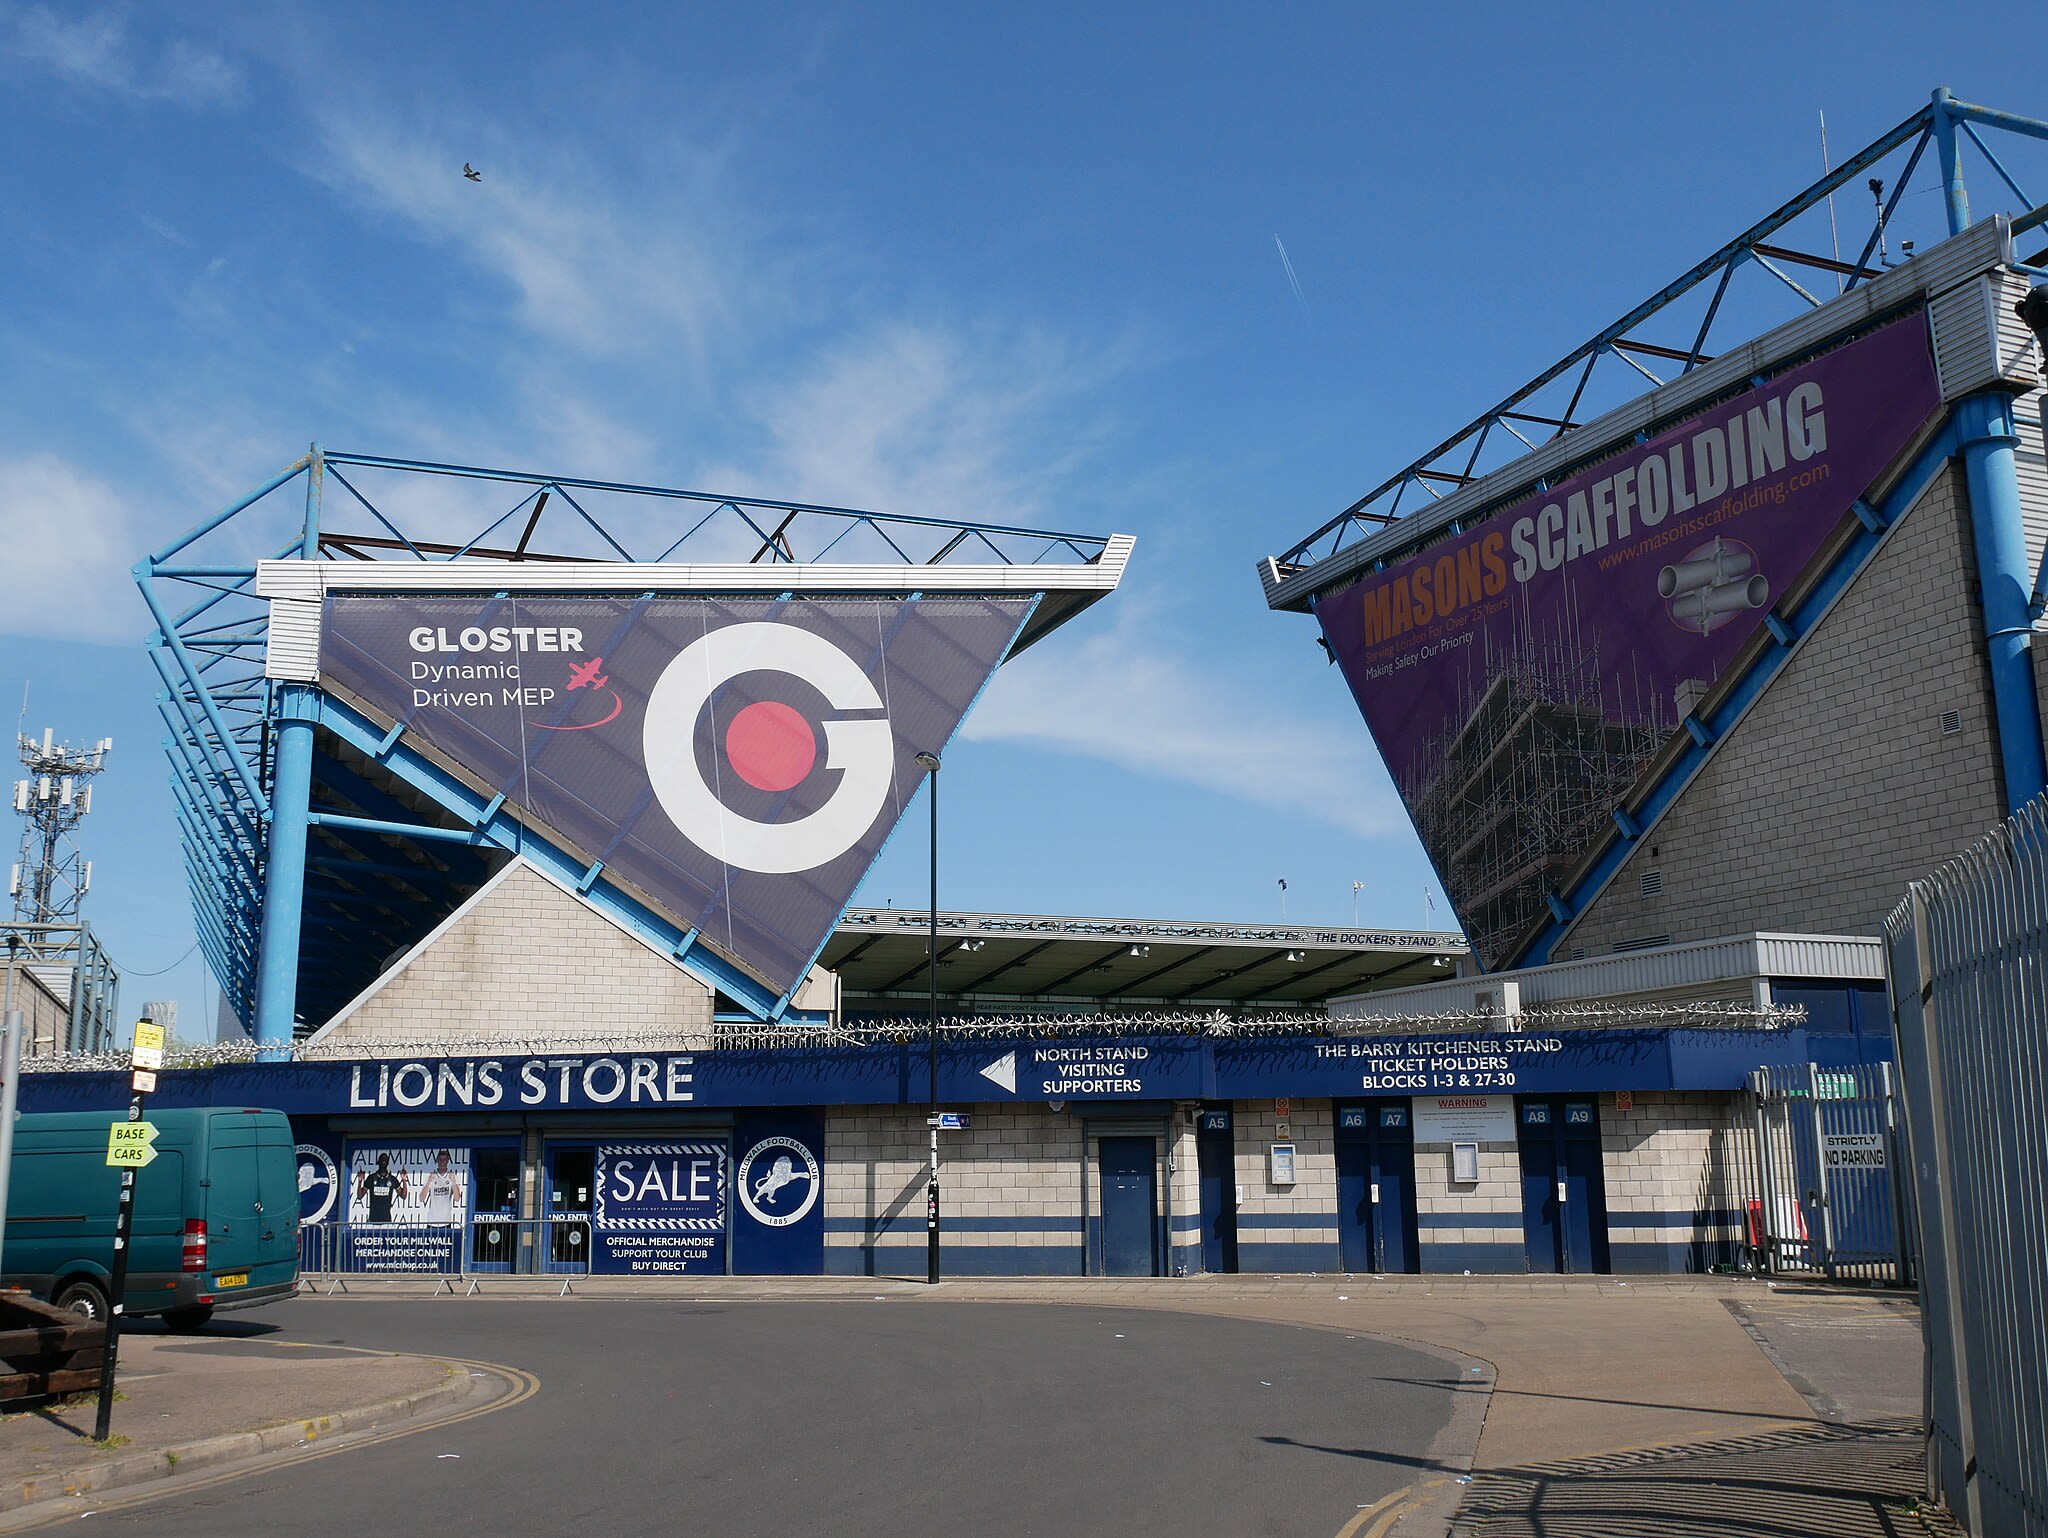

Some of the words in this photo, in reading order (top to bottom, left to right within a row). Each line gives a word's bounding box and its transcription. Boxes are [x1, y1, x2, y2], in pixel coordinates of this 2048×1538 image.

[1363, 532, 1507, 648] MASONS
[1511, 381, 1828, 583] SCAFFOLDING
[1598, 460, 1830, 571] www.masonsscaffolding.com
[1395, 632, 1427, 652] London
[1428, 624, 1443, 638] For
[1445, 614, 1469, 631] Over
[1471, 606, 1484, 621] 25
[1484, 598, 1510, 616] Years
[408, 627, 584, 652] GLOSTER
[1366, 663, 1394, 680] Making
[1394, 650, 1419, 671] Safety
[1420, 645, 1439, 660] Our
[1440, 630, 1474, 652] Priority
[411, 661, 520, 684] Dynamic
[413, 688, 493, 707] Driven
[503, 687, 555, 706] MEP
[1315, 932, 1337, 943] THE
[1340, 933, 1396, 945] DOCKERS
[1398, 935, 1437, 946] STAND
[1035, 1048, 1092, 1063] NORTH
[1095, 1046, 1149, 1060] STAND
[1314, 1045, 1347, 1057] THE
[1351, 1043, 1402, 1056] BARRY
[1407, 1040, 1501, 1055] KITCHENER
[1505, 1039, 1563, 1052] STAND
[1058, 1063, 1125, 1077] VISITING
[1368, 1058, 1426, 1072] TICKET
[1431, 1057, 1508, 1071] HOLDERS
[350, 1061, 503, 1107] LIONS
[520, 1056, 694, 1105] STORE
[1042, 1079, 1142, 1094] SUPPORTERS
[1363, 1075, 1427, 1089] BLOCKS
[1433, 1074, 1454, 1087] 1-3
[1458, 1074, 1470, 1087] &
[1474, 1073, 1516, 1087] 27-30
[1438, 1098, 1487, 1108] WARNING
[1208, 1118, 1225, 1129] A5
[1345, 1115, 1362, 1126] A6
[1386, 1115, 1401, 1126] A7
[1528, 1111, 1546, 1122] A8
[1571, 1111, 1588, 1122] A9
[116, 1128, 145, 1141] BASE
[1827, 1136, 1877, 1145] STRICTLY
[114, 1148, 143, 1160] CARS
[740, 1143, 766, 1181] MILLWALL
[766, 1137, 807, 1157] FOOTBALL
[807, 1156, 818, 1180] CLUB
[1825, 1150, 1839, 1165] NO
[1841, 1149, 1884, 1165] PARKING
[611, 1160, 711, 1202] SALE
[474, 1214, 516, 1222] ENTRANCE
[552, 1213, 565, 1221] NO
[567, 1213, 593, 1221] ENTRY
[769, 1217, 788, 1225] 1885
[354, 1237, 383, 1245] ORDER
[385, 1237, 408, 1245] YOUR
[410, 1237, 453, 1246] MILLWALL
[606, 1237, 648, 1246] OFFICIAL
[649, 1237, 715, 1247] MERCHANDISE
[355, 1249, 416, 1257] MERCHANDISE
[417, 1249, 450, 1257] ONLINE
[612, 1249, 654, 1258] SUPPORT
[655, 1249, 681, 1258] YOUR
[683, 1249, 708, 1259] CLUB
[632, 1262, 651, 1271] BUY
[653, 1262, 687, 1271] DIRECT
